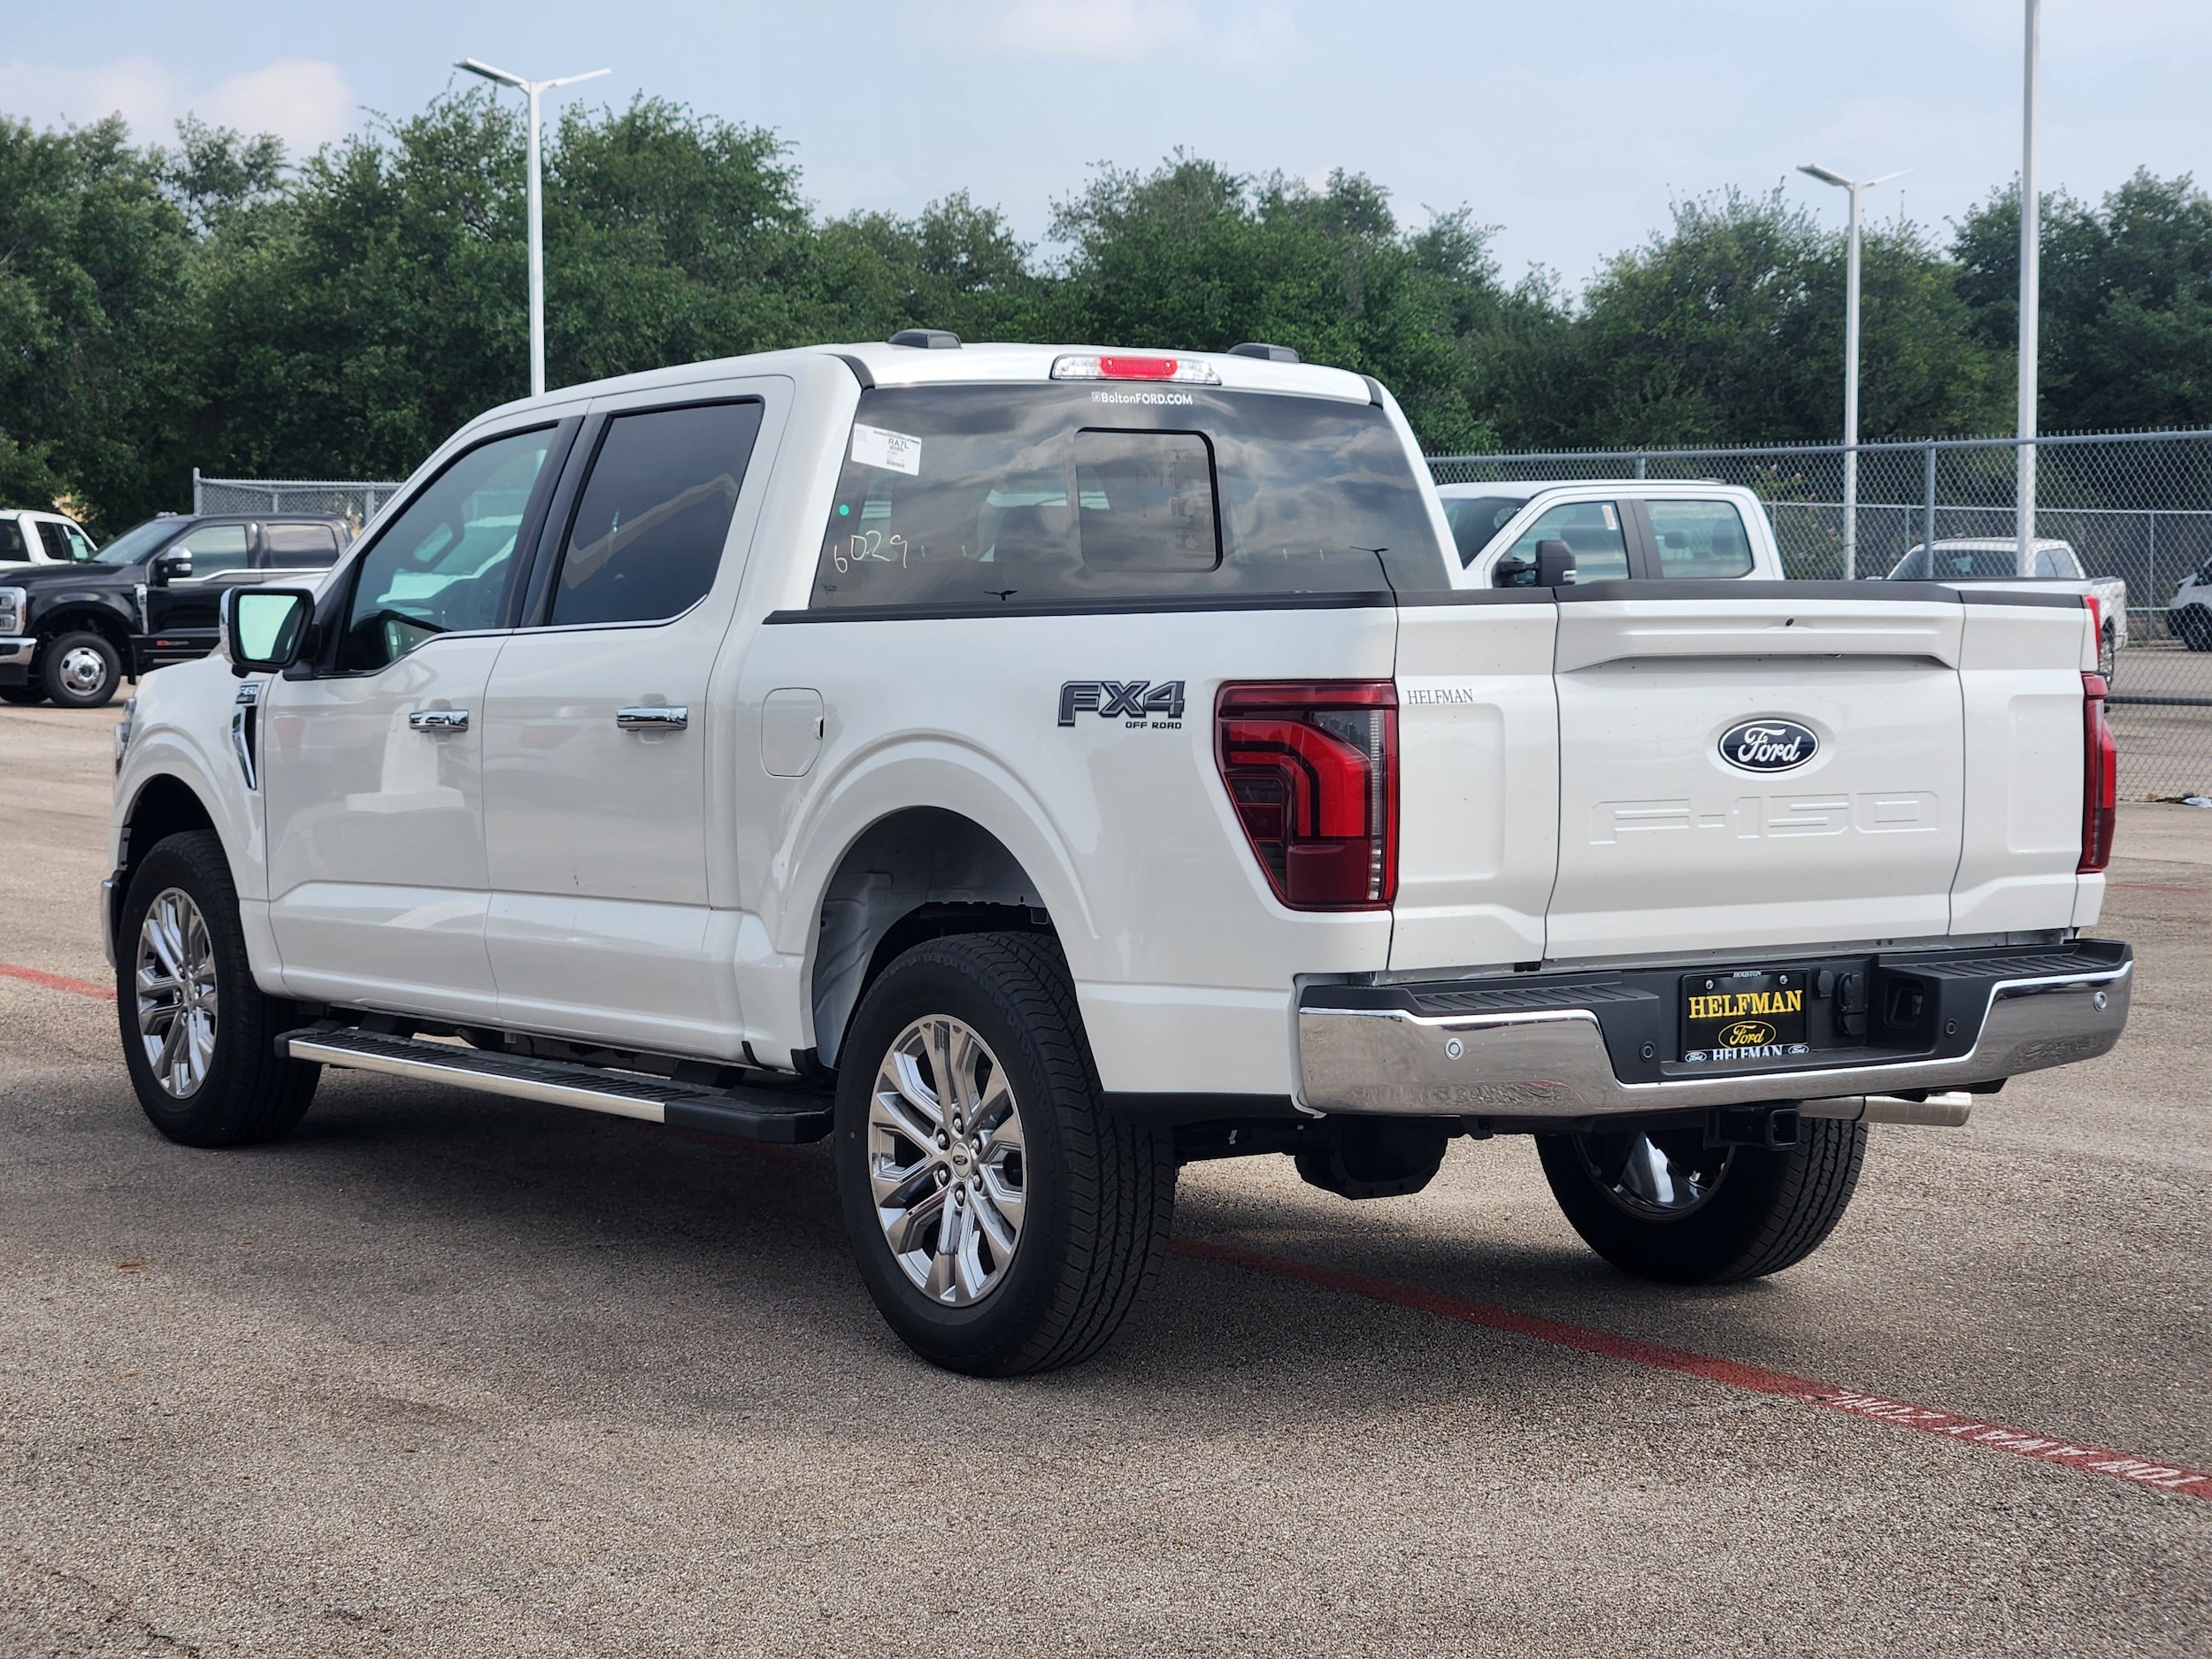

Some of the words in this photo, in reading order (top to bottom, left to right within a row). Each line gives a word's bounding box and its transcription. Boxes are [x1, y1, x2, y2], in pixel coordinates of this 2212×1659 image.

[834, 531, 907, 572] 6029
[1057, 680, 1186, 727] FX4
[1407, 687, 1474, 705] HELFMAN
[1151, 721, 1182, 730] ROAD
[1738, 726, 1801, 764] Ford
[1589, 790, 1939, 845] F-150
[1688, 989, 1802, 1018] HELFMAN
[1729, 1025, 1767, 1045] Ford
